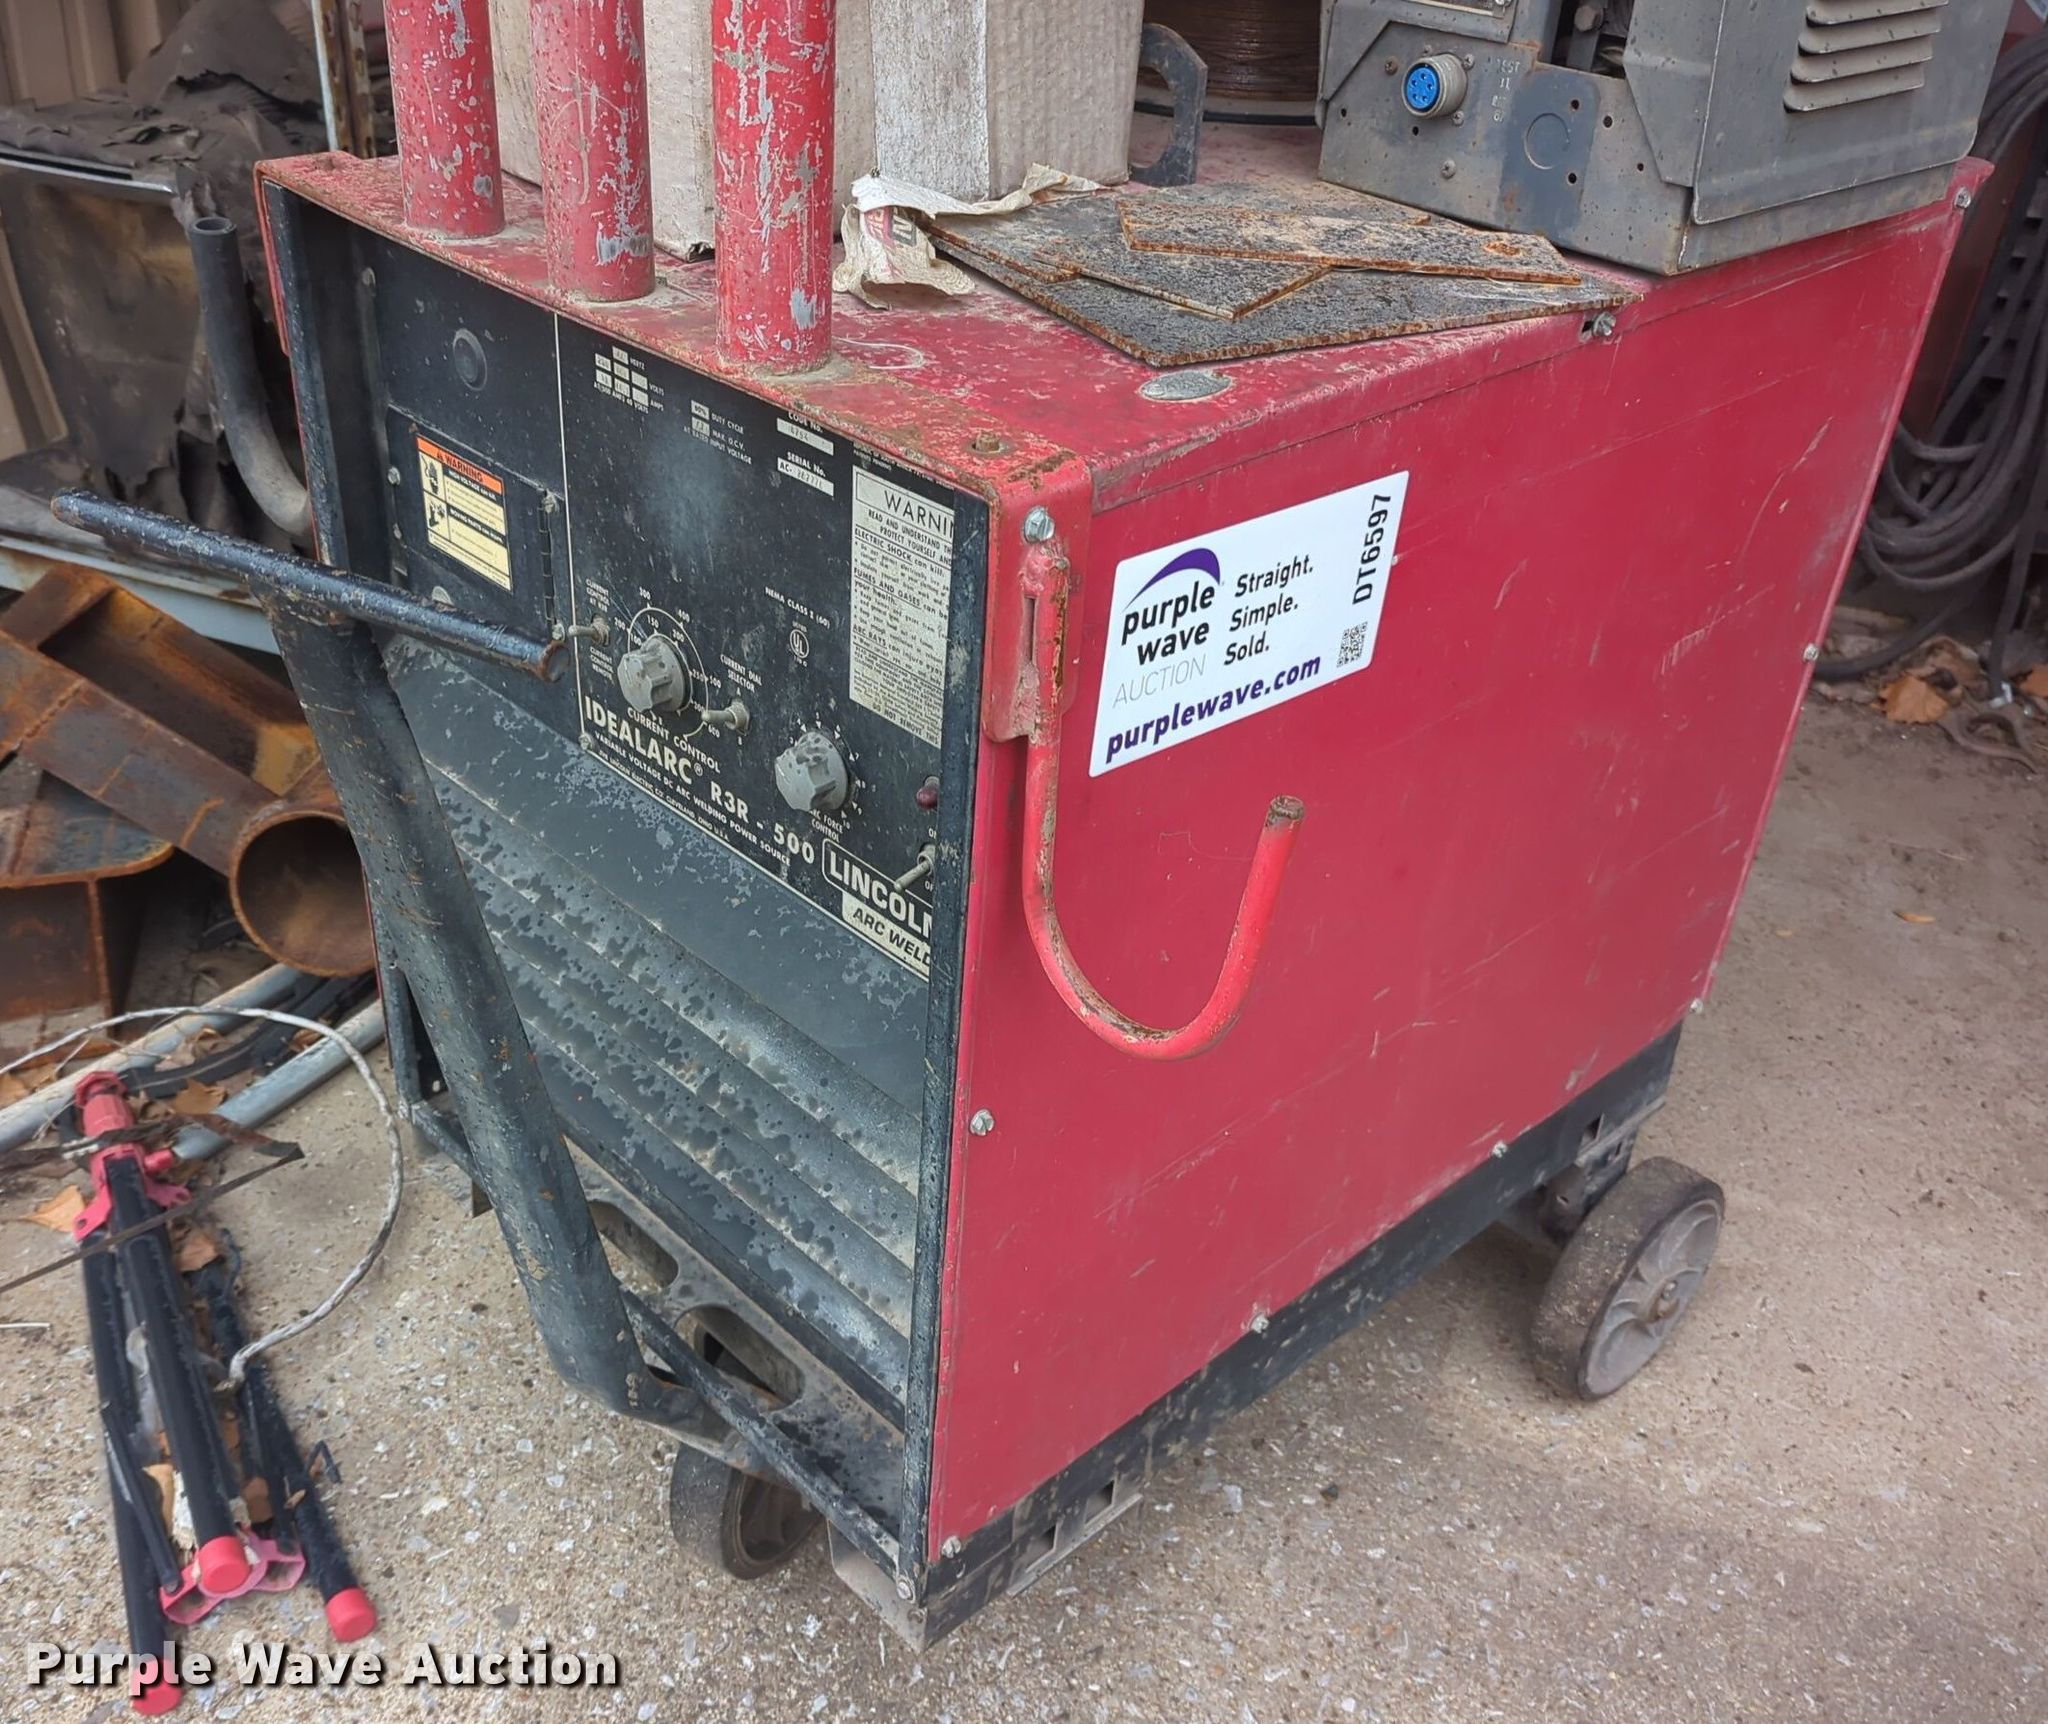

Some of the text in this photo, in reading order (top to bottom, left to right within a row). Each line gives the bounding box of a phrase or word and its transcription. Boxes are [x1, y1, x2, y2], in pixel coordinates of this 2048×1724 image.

[446, 455, 482, 482] WARNING
[787, 451, 811, 470] SERIAL
[855, 527, 883, 547] ELECTRIC
[888, 543, 911, 561] SHOCK
[869, 509, 882, 522] READ
[886, 518, 897, 530] AND
[902, 525, 939, 550] UNDERSTAND
[880, 525, 903, 543] PROTECT
[908, 539, 935, 558] YOURSELF
[1352, 494, 1392, 605] DT6597
[854, 567, 875, 583] FUMES
[879, 580, 894, 593] AND
[1235, 554, 1314, 598] Straight.
[765, 586, 785, 603] NEMA
[787, 599, 807, 616] CLASS
[1121, 581, 1216, 646] purple
[1229, 594, 1299, 632] Simple.
[647, 614, 659, 628] 150
[853, 623, 865, 635] ARC
[1137, 622, 1210, 666] wave
[1224, 631, 1270, 667] Sold.
[720, 653, 762, 687] CURRENT DIAL
[727, 669, 755, 693] SELECTOR
[1113, 653, 1206, 709] AUCTION
[1106, 657, 1321, 764] purplewave.com
[627, 706, 721, 774] CURRENT CONTROL
[595, 731, 791, 867] VARIABLE VOLTAGE DC ARC WELDING POWER SOURCE
[710, 780, 749, 824] R3R
[773, 822, 815, 865] 500
[811, 818, 840, 842] CONTROL
[823, 813, 843, 834] FORCE
[852, 908, 885, 936] ARC
